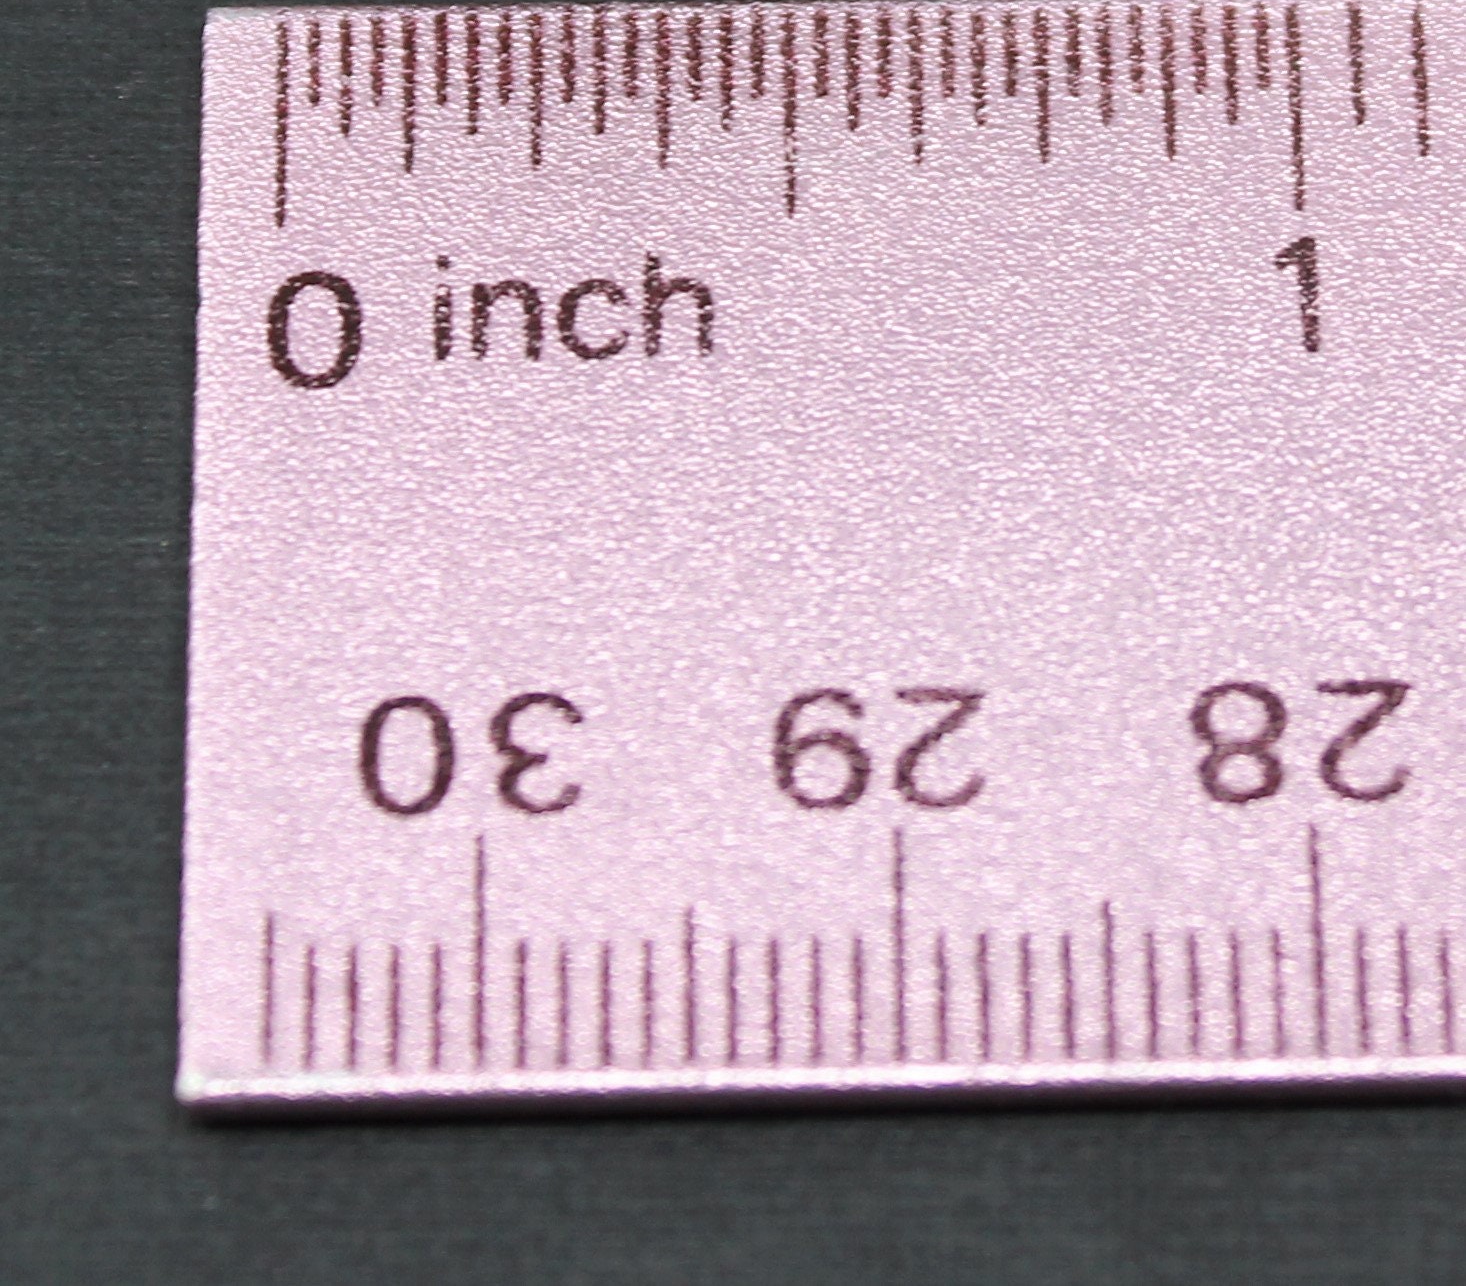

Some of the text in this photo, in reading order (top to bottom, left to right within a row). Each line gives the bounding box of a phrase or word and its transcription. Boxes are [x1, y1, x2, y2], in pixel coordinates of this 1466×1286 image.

[267, 251, 715, 390] 0 inch
[1273, 236, 1320, 354] 1
[359, 691, 585, 817] 30
[774, 687, 986, 809] 29
[1189, 680, 1411, 804] 28
